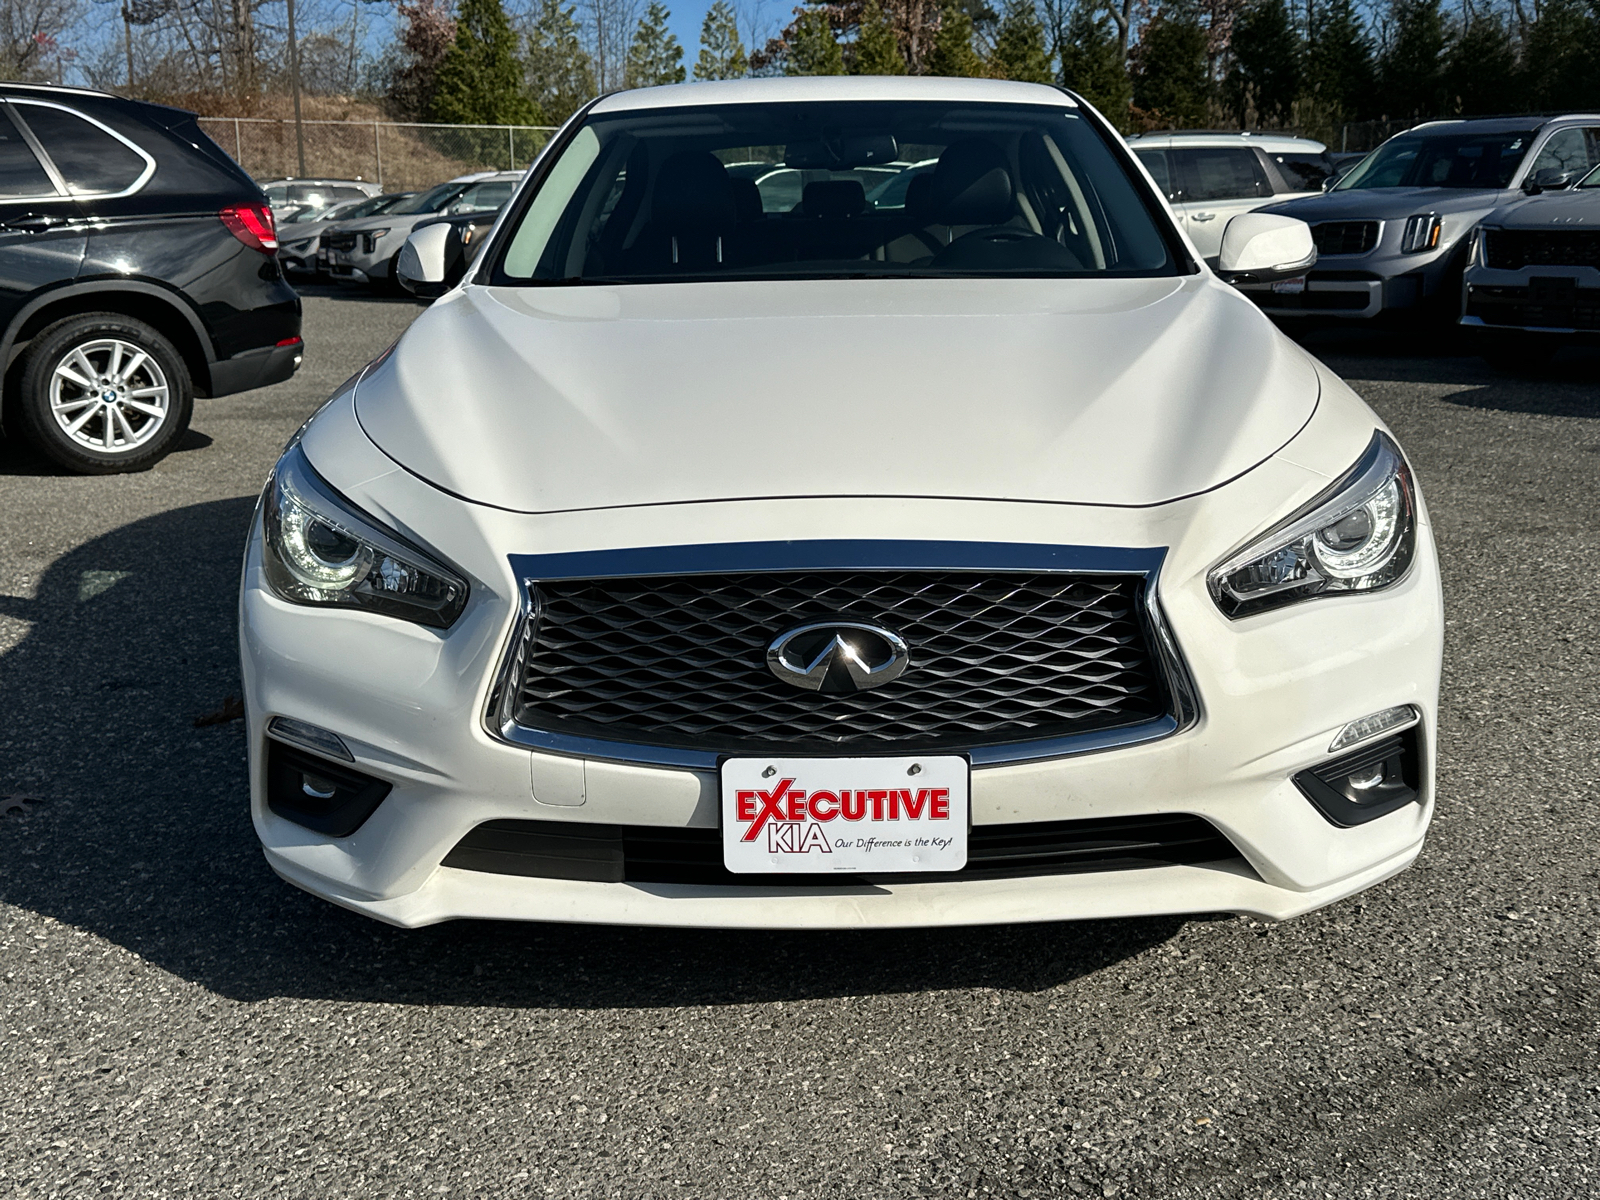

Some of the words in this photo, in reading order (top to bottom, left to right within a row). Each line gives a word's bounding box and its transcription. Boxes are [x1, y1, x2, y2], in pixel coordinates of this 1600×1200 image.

[735, 777, 950, 842] EXECUTIVE
[768, 823, 833, 853] KIA
[834, 838, 853, 848] Our
[856, 837, 902, 852] Difference
[904, 838, 912, 847] is
[914, 837, 929, 847] the
[930, 837, 953, 851] Key!
